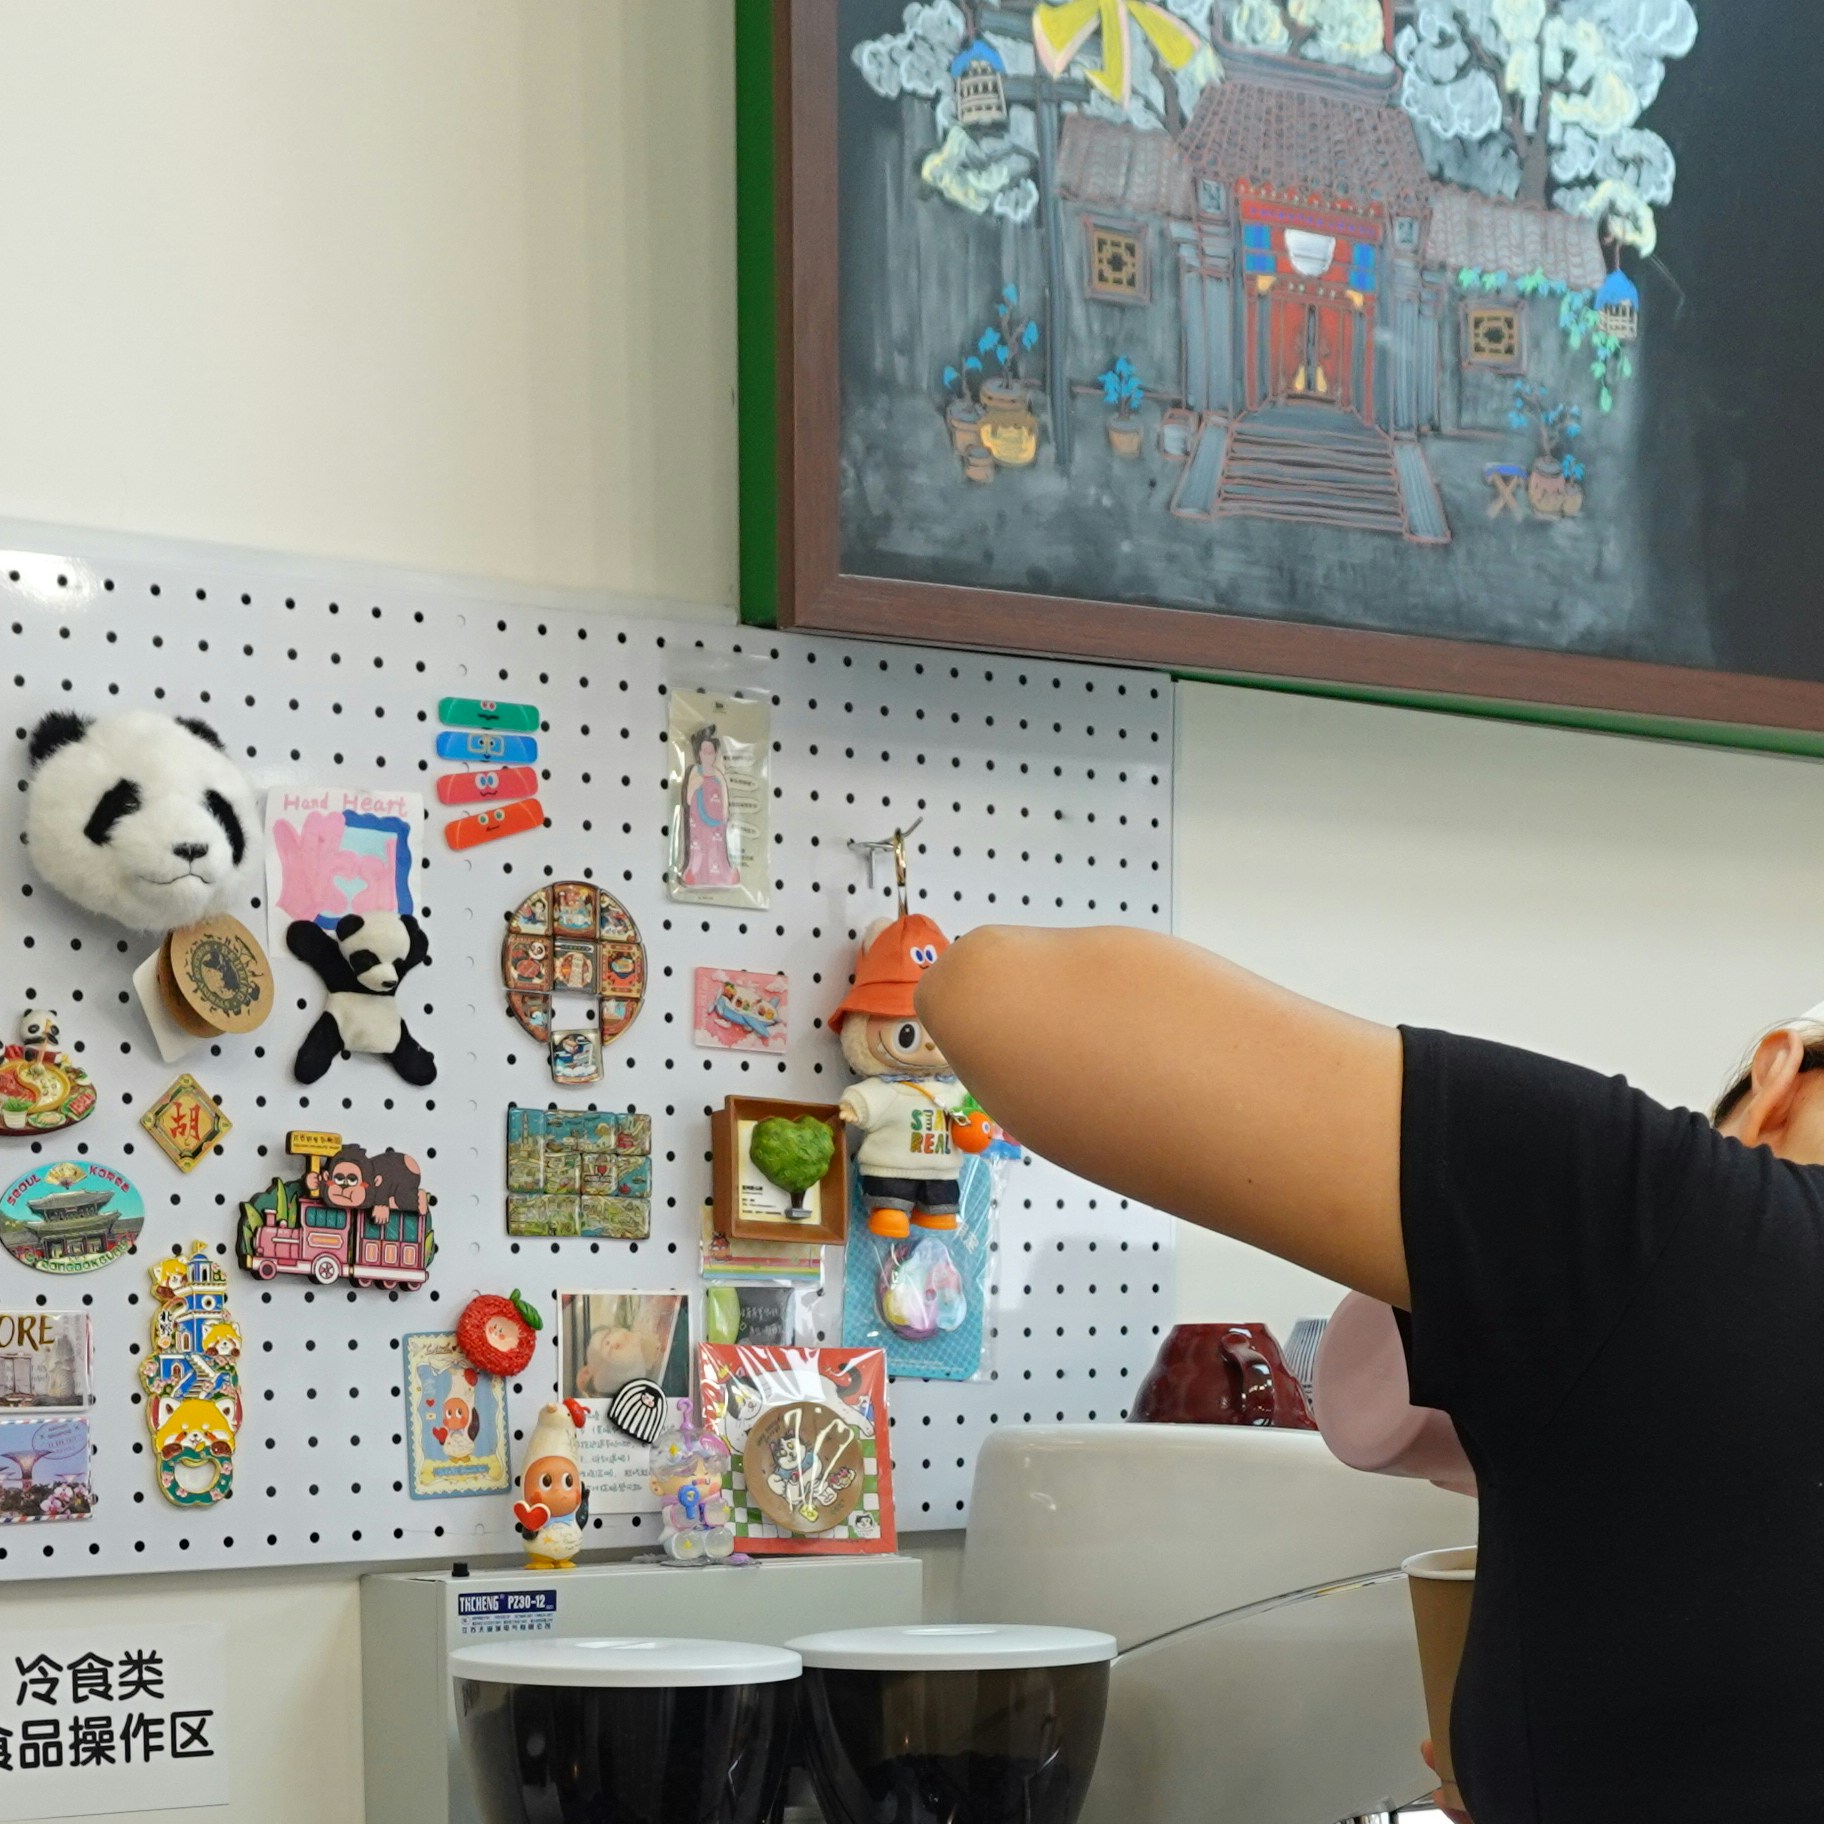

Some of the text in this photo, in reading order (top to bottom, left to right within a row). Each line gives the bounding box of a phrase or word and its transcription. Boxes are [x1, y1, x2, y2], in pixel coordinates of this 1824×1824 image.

[283, 791, 408, 817] Hand Heart
[170, 1101, 201, 1141] 胡
[910, 1131, 951, 1155] REAL
[507, 1594, 546, 1609] PZ30-12
[15, 1649, 165, 1706] 冷食类
